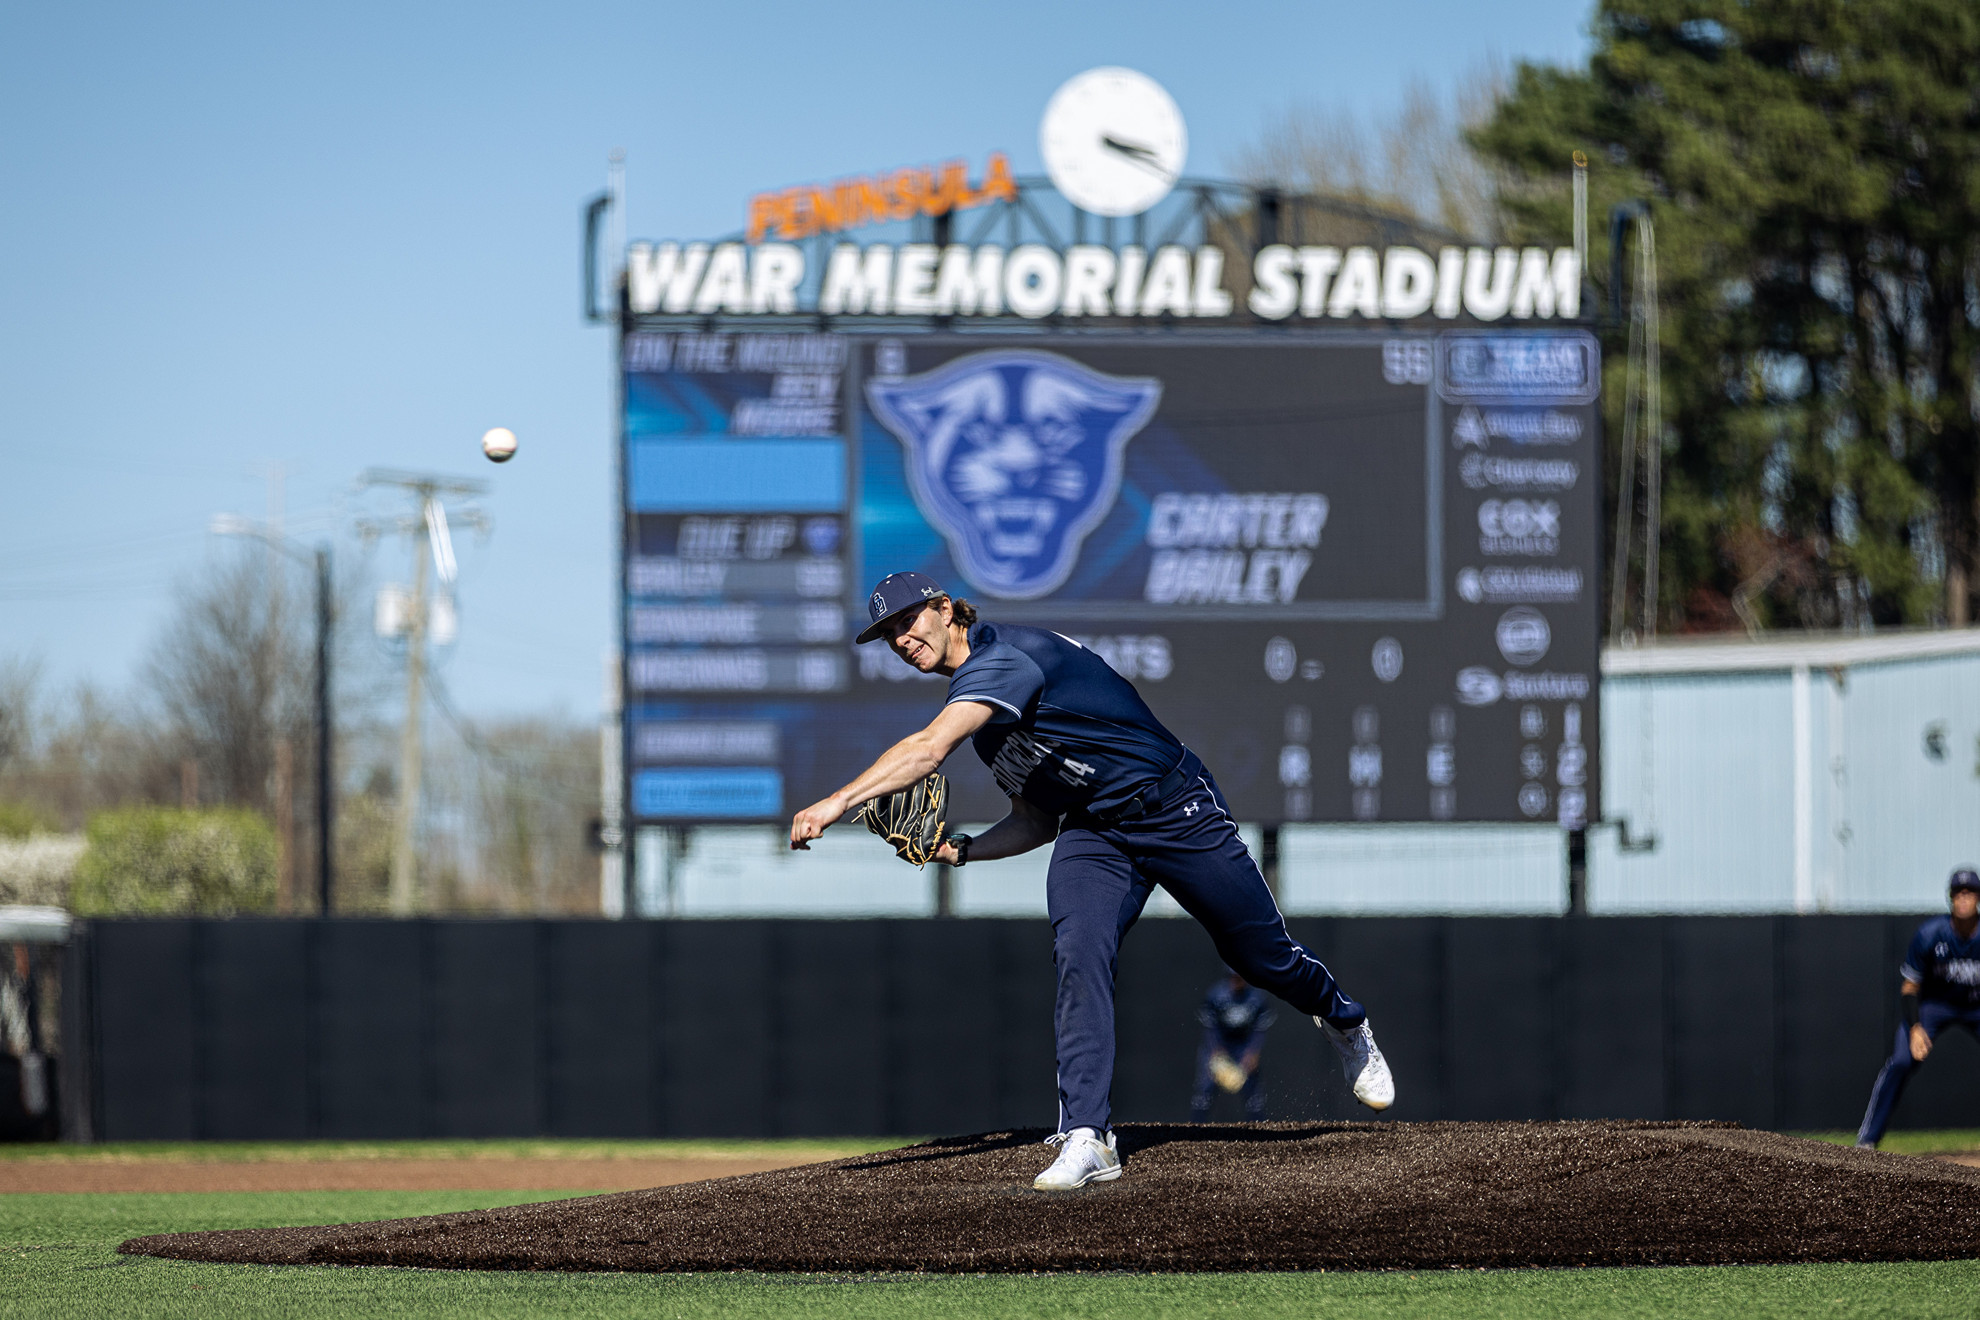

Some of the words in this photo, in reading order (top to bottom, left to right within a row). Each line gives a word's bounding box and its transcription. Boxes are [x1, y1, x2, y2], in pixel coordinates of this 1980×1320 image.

[748, 154, 1016, 241] PENINSULA
[628, 241, 805, 315] WAR
[819, 242, 1233, 319] MEMORIAL
[1247, 244, 1581, 321] STADIUM
[1146, 492, 1330, 549] CARTER
[1478, 498, 1561, 538] COX
[1144, 549, 1315, 604] BAILEY
[1264, 635, 1297, 683] 0
[1371, 635, 1404, 683] 0
[1058, 758, 1096, 787] 44
